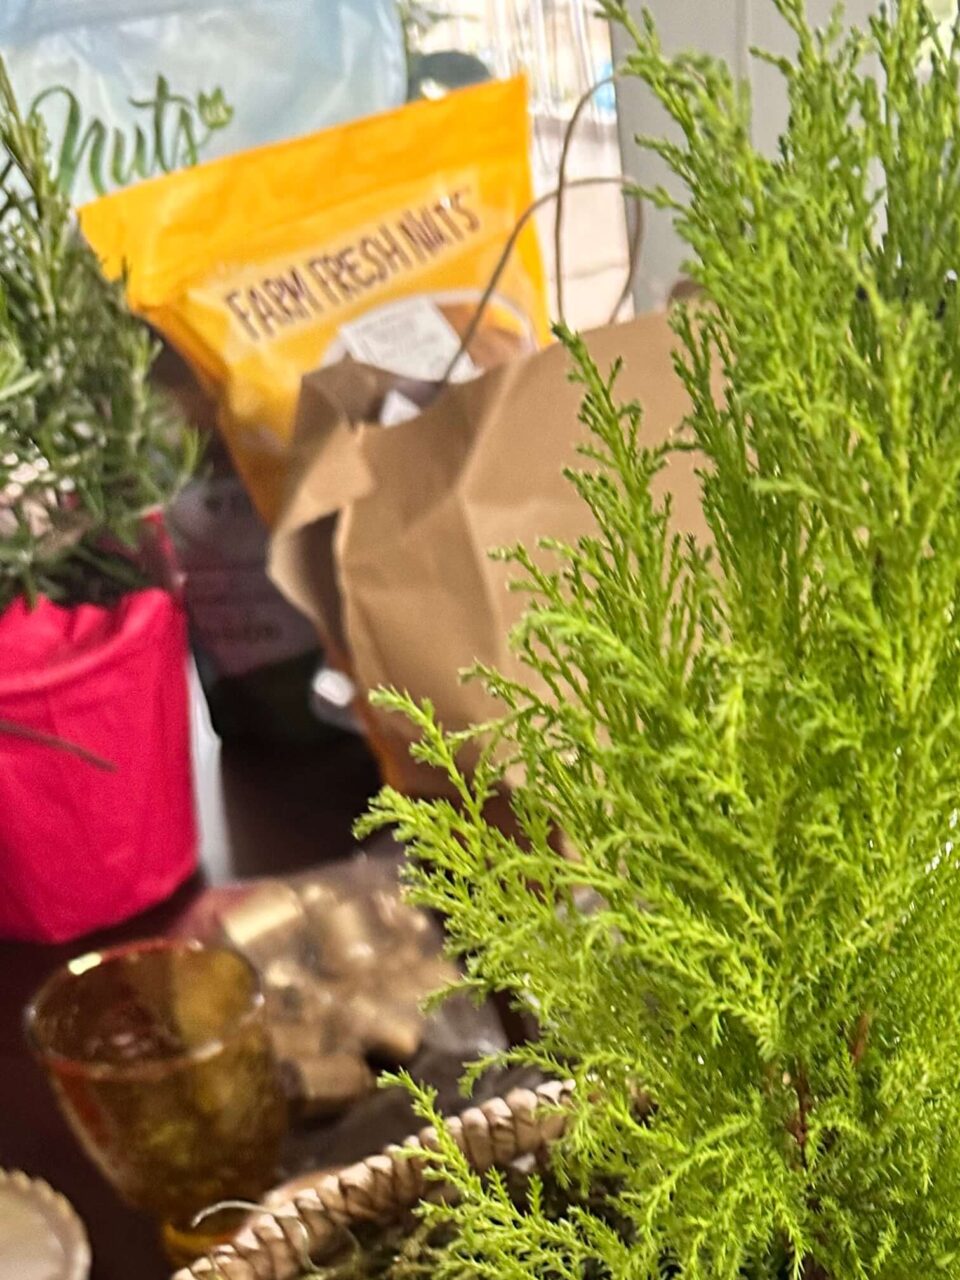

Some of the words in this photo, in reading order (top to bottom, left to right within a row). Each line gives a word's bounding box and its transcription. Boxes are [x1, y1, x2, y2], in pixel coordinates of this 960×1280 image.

[226, 265, 324, 340] FARM
[307, 223, 413, 304] FRESH
[398, 187, 480, 263] NUTS
